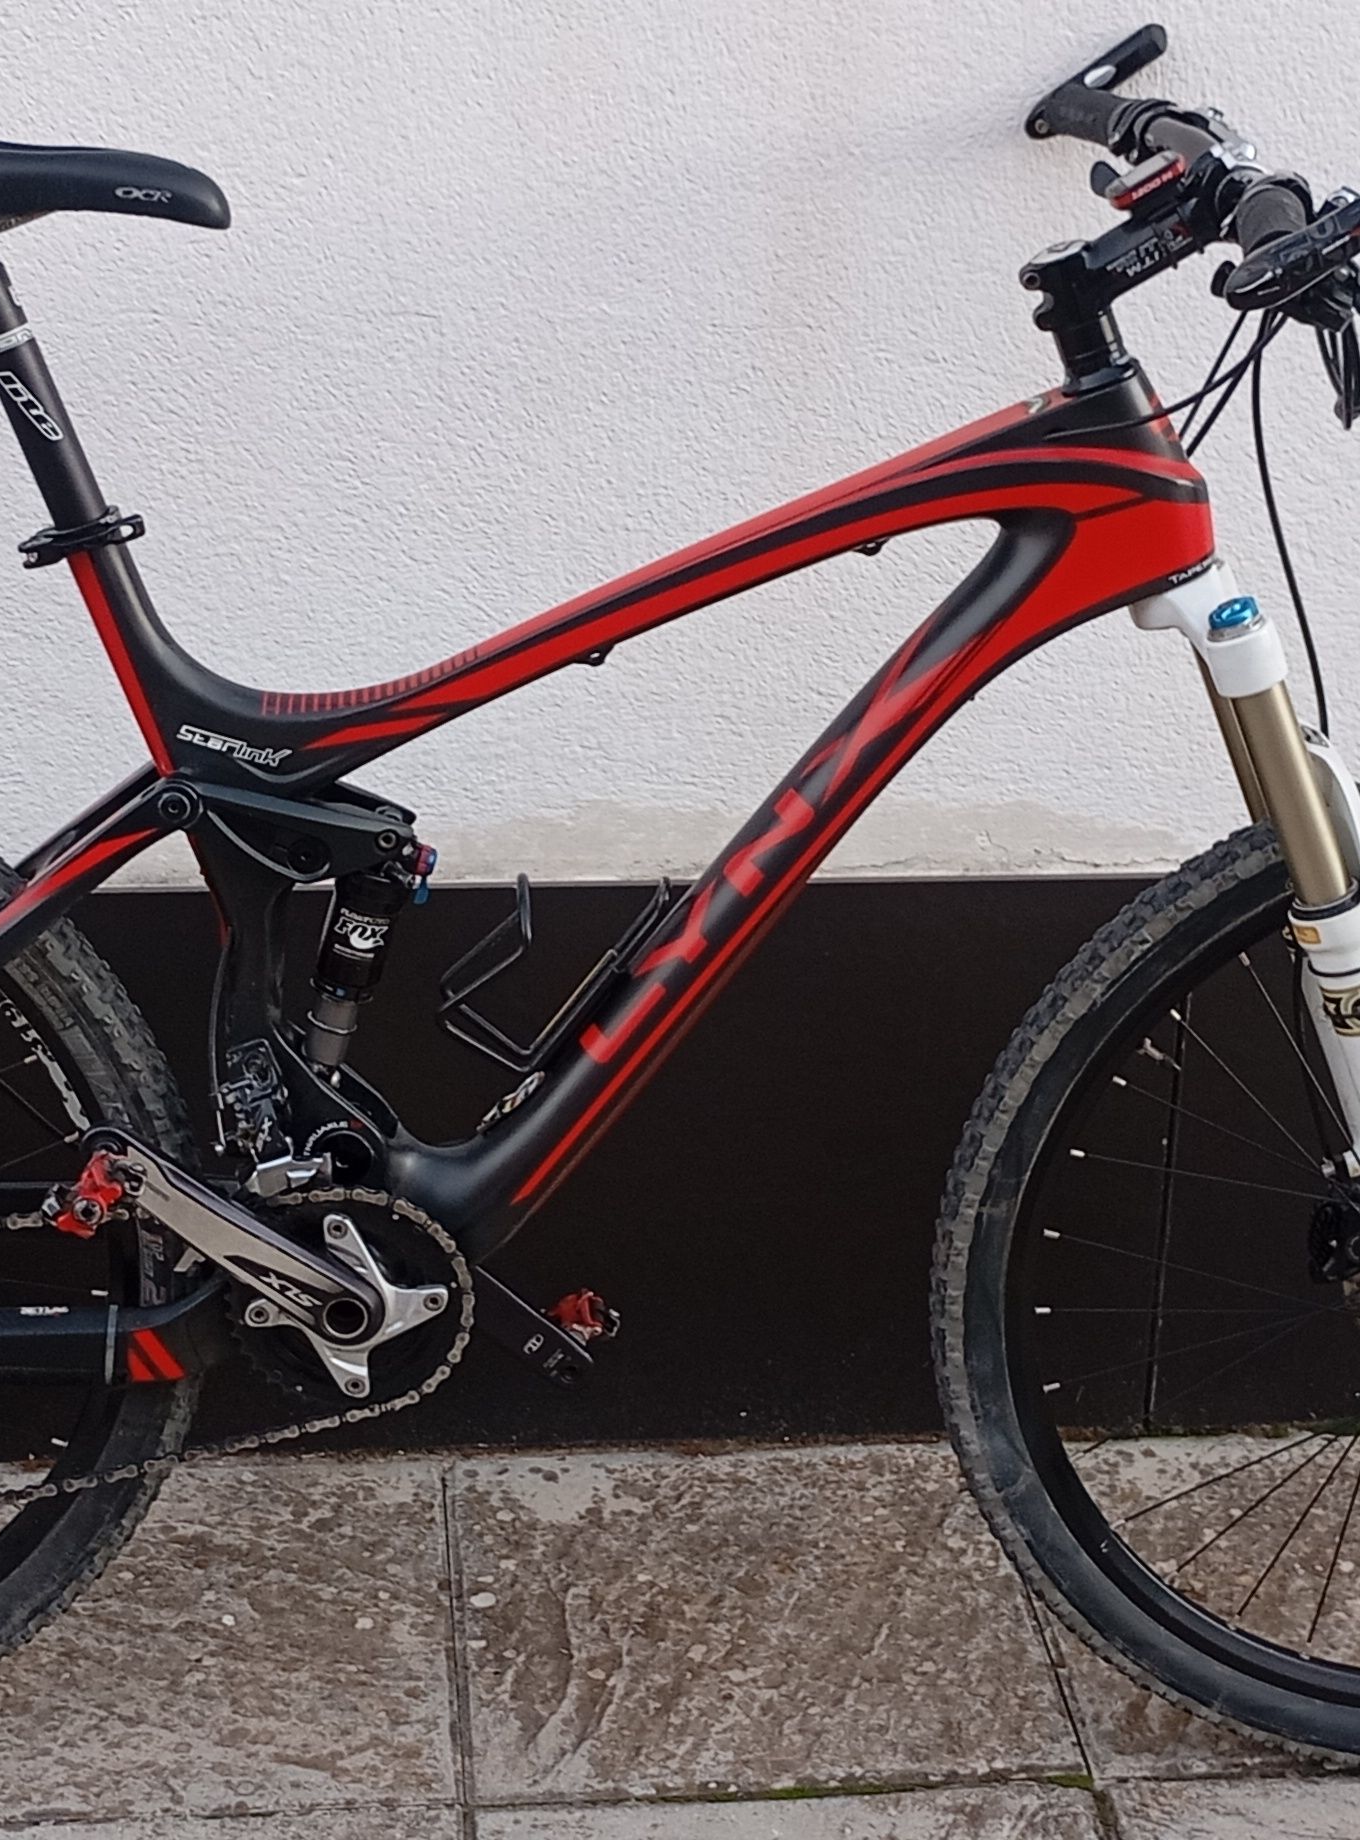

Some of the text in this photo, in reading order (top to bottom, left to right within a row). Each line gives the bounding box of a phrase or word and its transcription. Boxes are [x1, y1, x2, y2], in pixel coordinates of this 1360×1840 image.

[114, 186, 172, 203] OCR
[580, 605, 960, 1063] LYNX
[334, 916, 389, 946] FOX
